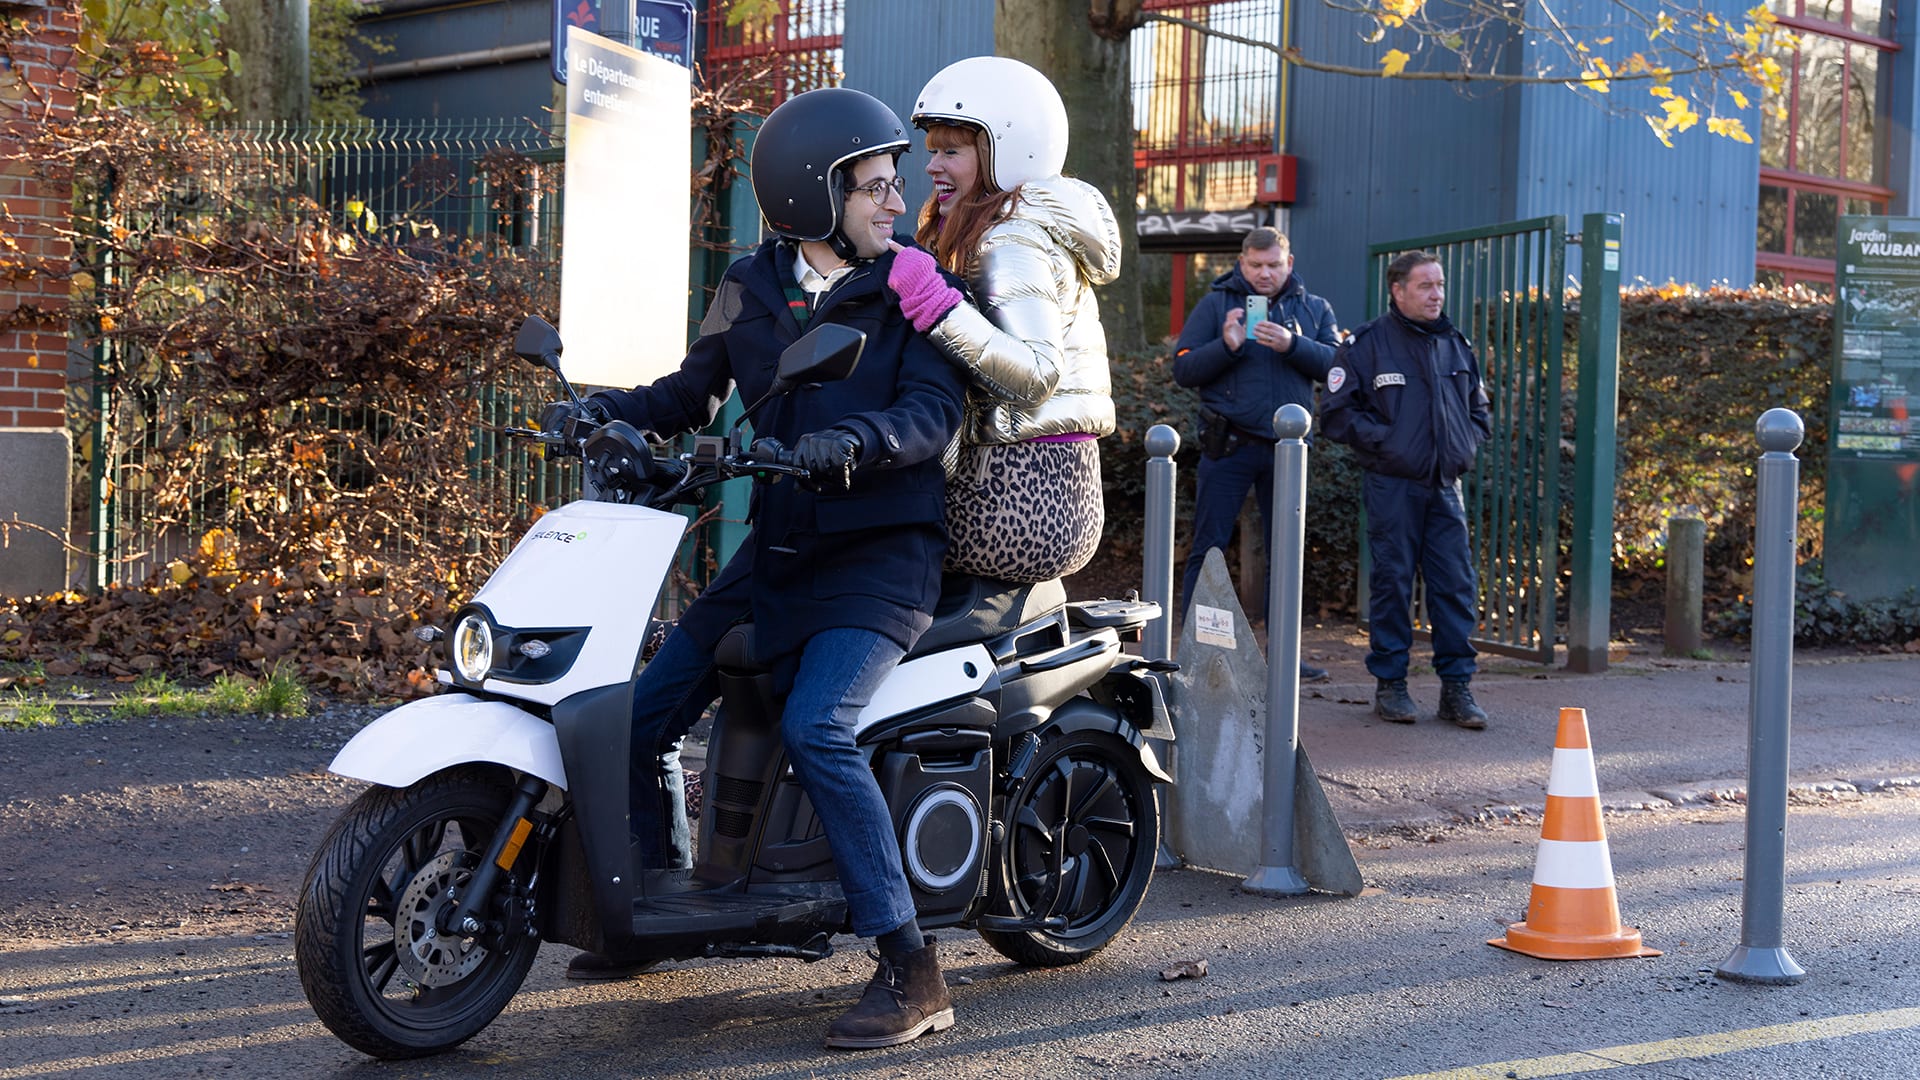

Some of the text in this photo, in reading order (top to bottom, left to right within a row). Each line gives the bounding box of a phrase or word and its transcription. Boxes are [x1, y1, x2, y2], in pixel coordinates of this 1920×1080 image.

[634, 15, 660, 38] RUE
[574, 53, 587, 73] Le
[588, 57, 652, 91] Départem
[1848, 228, 1887, 245] Jardin
[1374, 375, 1405, 386] OLICE
